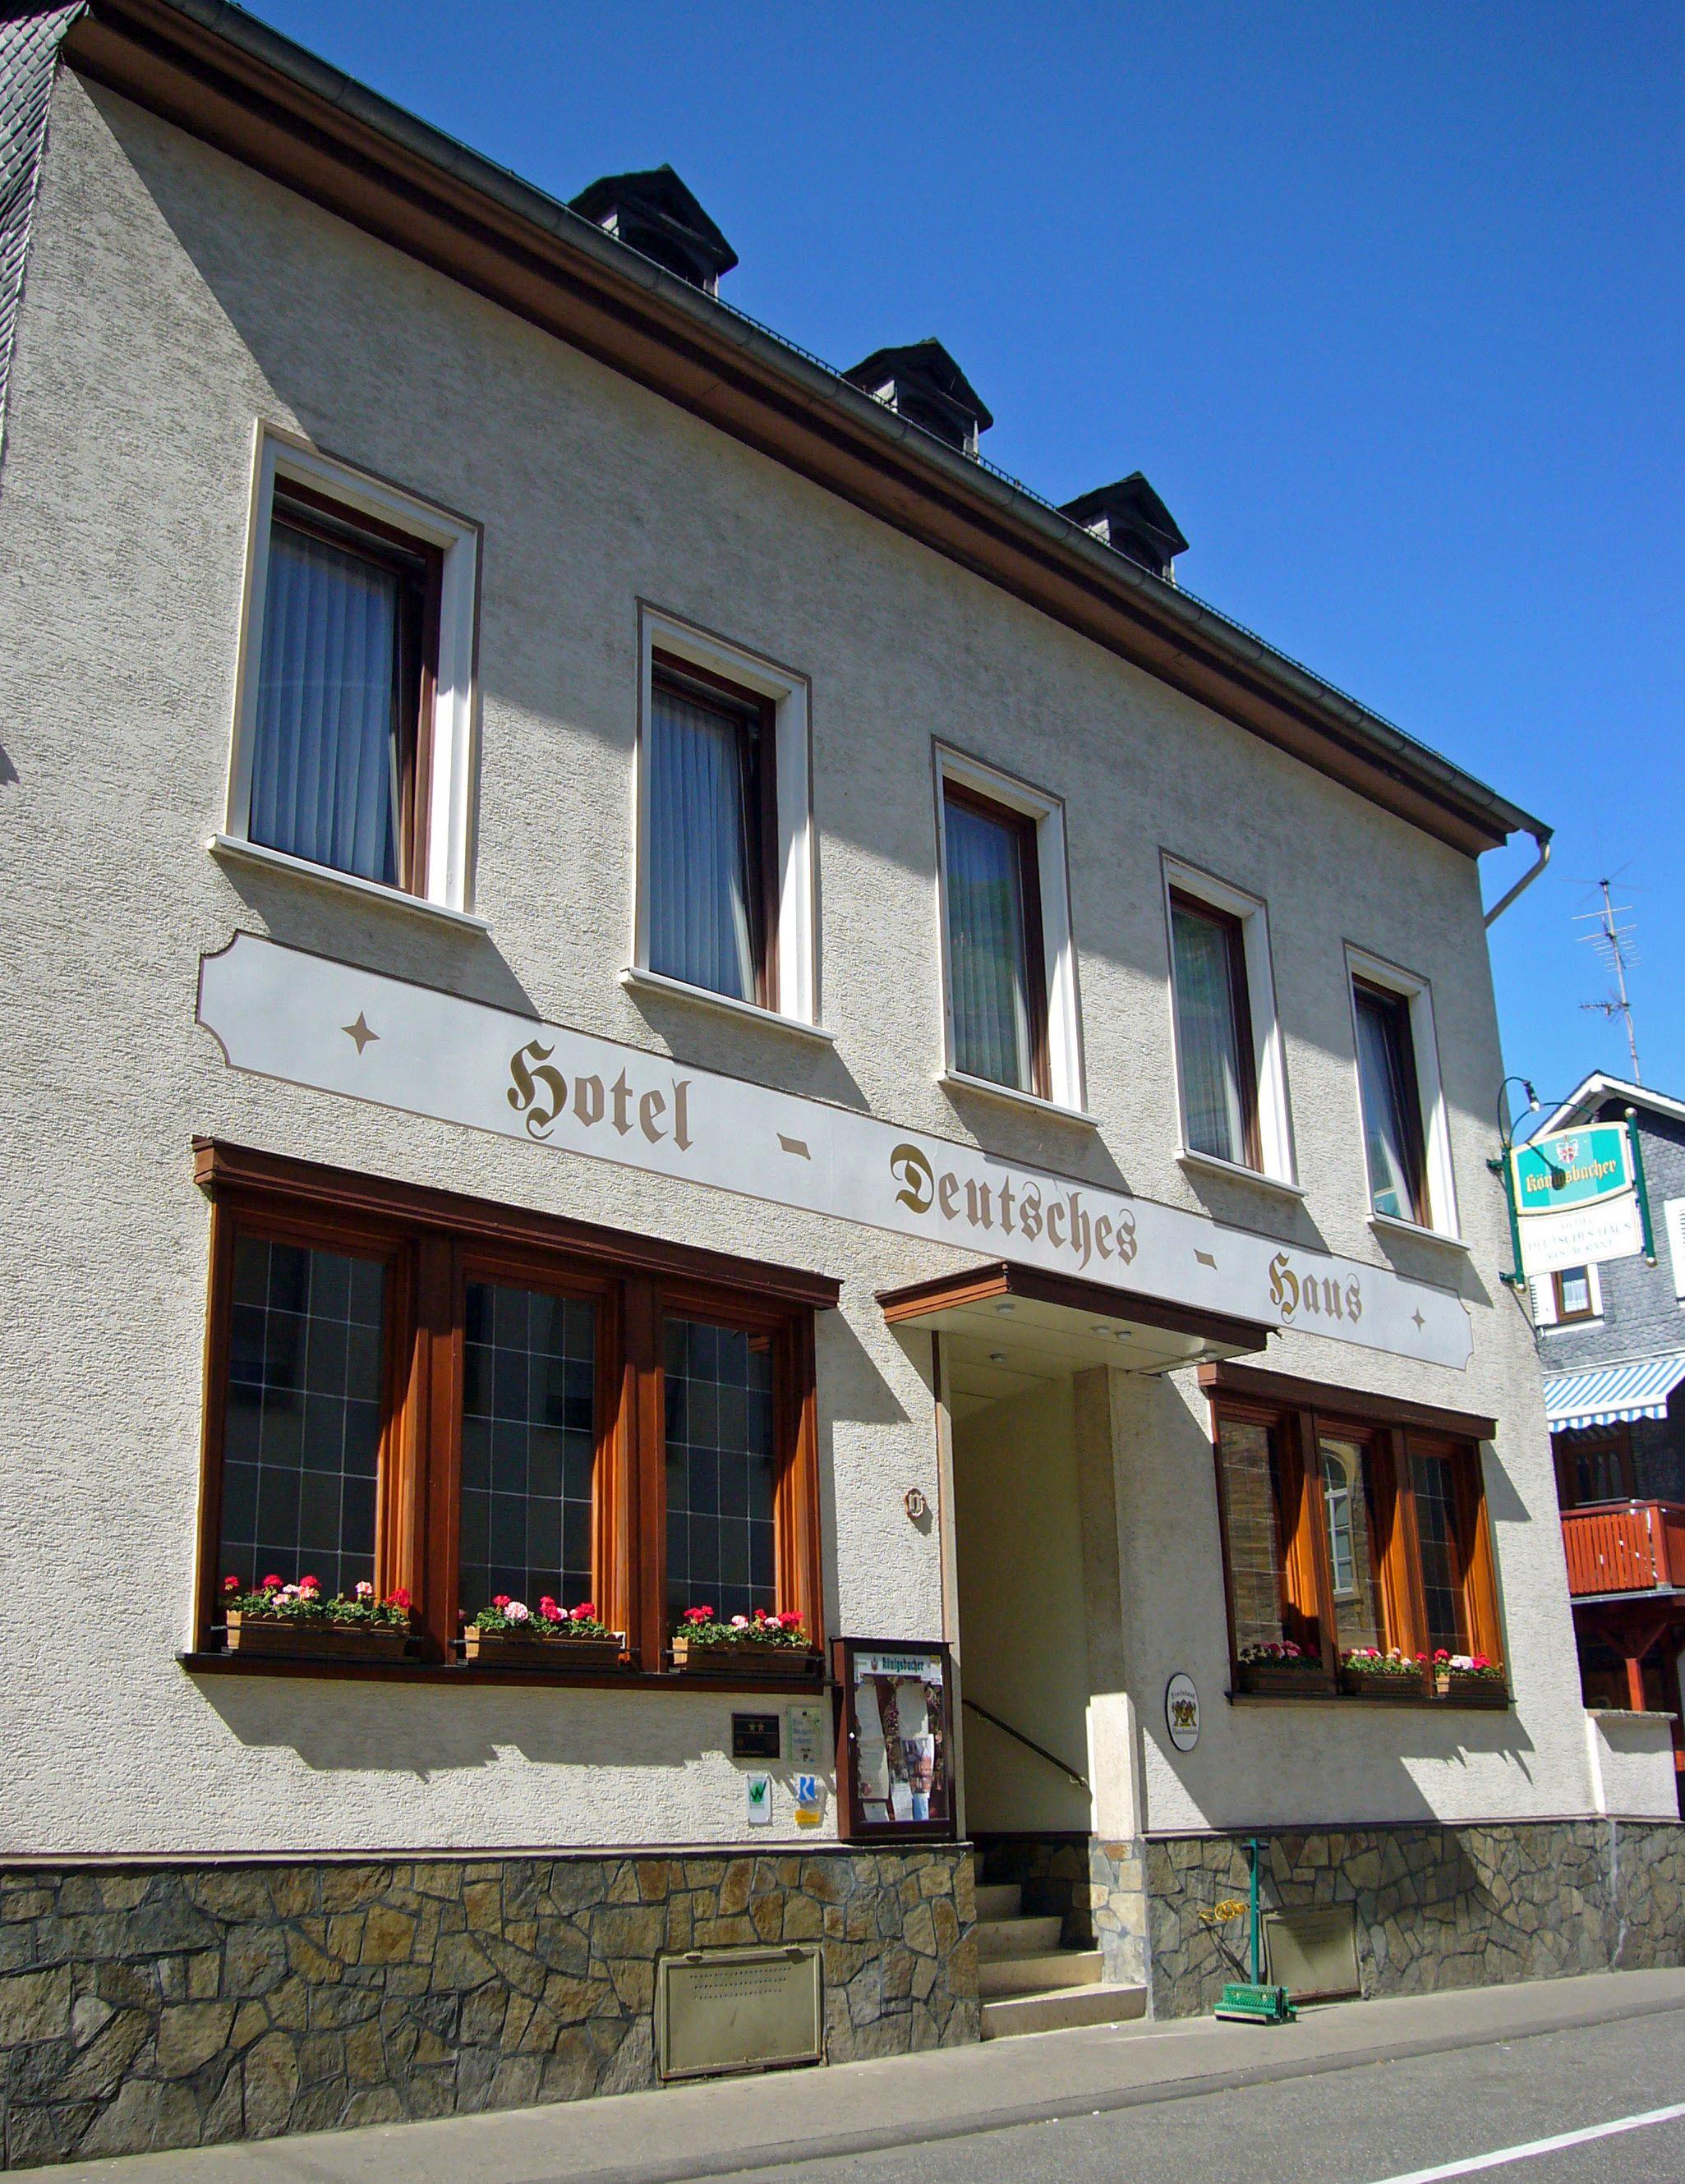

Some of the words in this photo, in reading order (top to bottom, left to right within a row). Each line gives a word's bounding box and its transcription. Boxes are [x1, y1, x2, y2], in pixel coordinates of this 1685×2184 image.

[507, 1039, 694, 1152] Hotel
[890, 1143, 1138, 1271] Deutsches
[1268, 1251, 1362, 1324] Haus
[1526, 1159, 1616, 1193] Könsbacher
